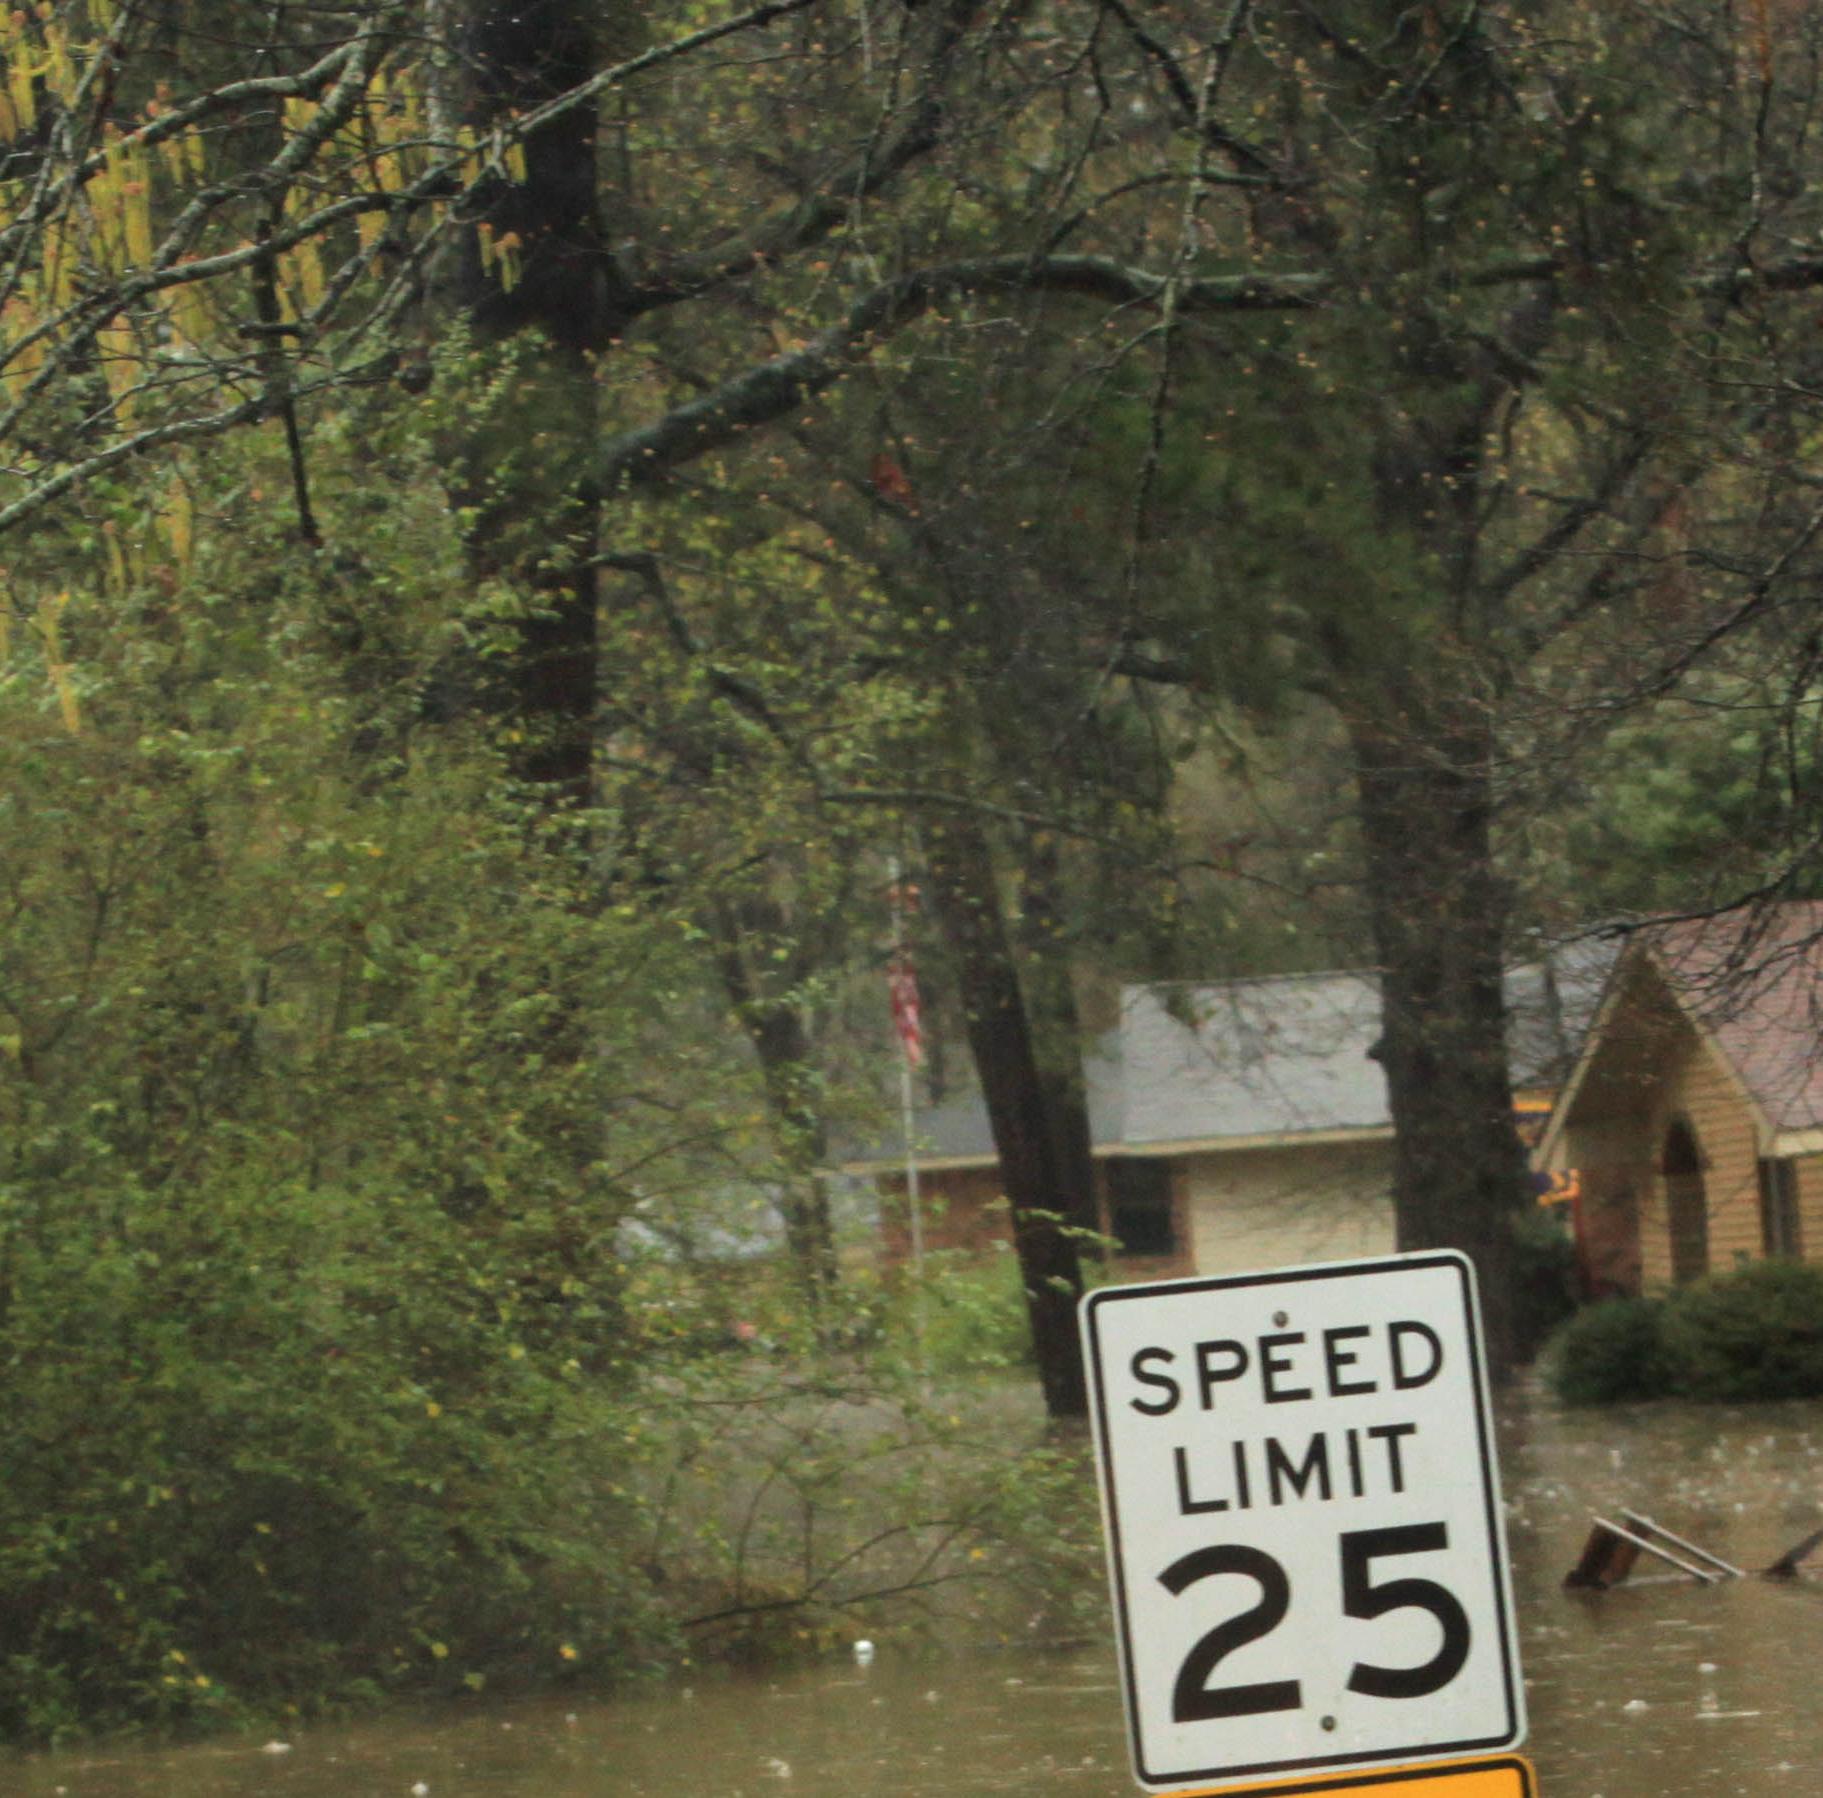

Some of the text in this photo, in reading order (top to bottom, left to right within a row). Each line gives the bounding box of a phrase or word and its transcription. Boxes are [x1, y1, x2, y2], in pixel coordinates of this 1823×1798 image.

[1129, 1319, 1444, 1417] SPEED
[1172, 1421, 1417, 1516] LIMIT
[1155, 1520, 1472, 1724] 25
